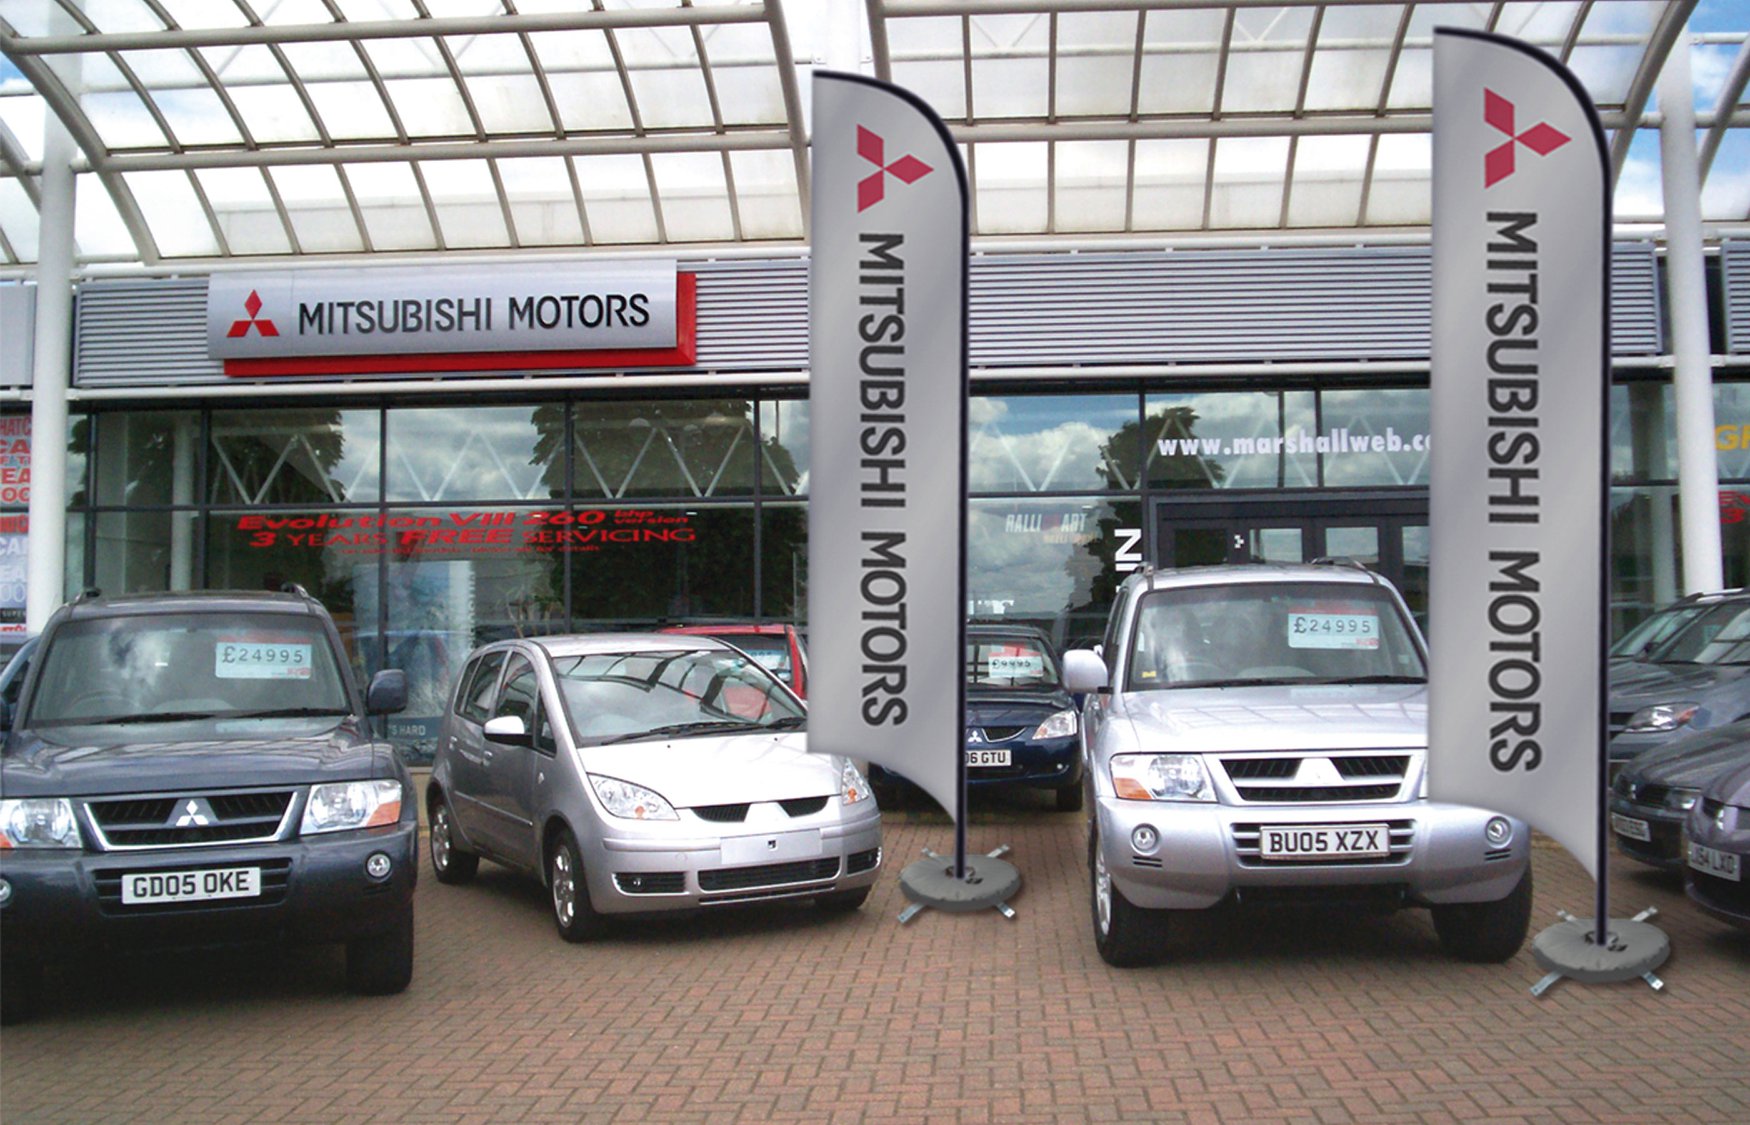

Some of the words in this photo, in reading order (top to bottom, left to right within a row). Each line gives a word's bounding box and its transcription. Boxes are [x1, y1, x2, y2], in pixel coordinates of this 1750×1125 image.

[299, 296, 493, 336] MITSUBISHI
[509, 293, 650, 330] MOTORS
[858, 233, 906, 508] MITSUBISHI
[1486, 211, 1540, 524] MITSUBISHI
[237, 513, 443, 530] Evolution
[449, 511, 516, 526] VIII
[522, 510, 607, 525] 260
[1004, 513, 1043, 532] RALLI
[1060, 513, 1088, 532] ART
[250, 531, 278, 548] 3
[286, 532, 388, 547] YEARS
[399, 528, 514, 545] FREE
[522, 528, 697, 544] SERVICING
[860, 532, 908, 726] MOTORS
[1294, 616, 1371, 634] £24995
[223, 645, 304, 664] £24995
[1488, 551, 1542, 773] MOTORS
[981, 752, 1006, 764] GTU
[1269, 831, 1329, 852] BU05
[1335, 829, 1380, 851] XZX
[133, 873, 196, 898] GD05
[203, 870, 250, 893] OKE
